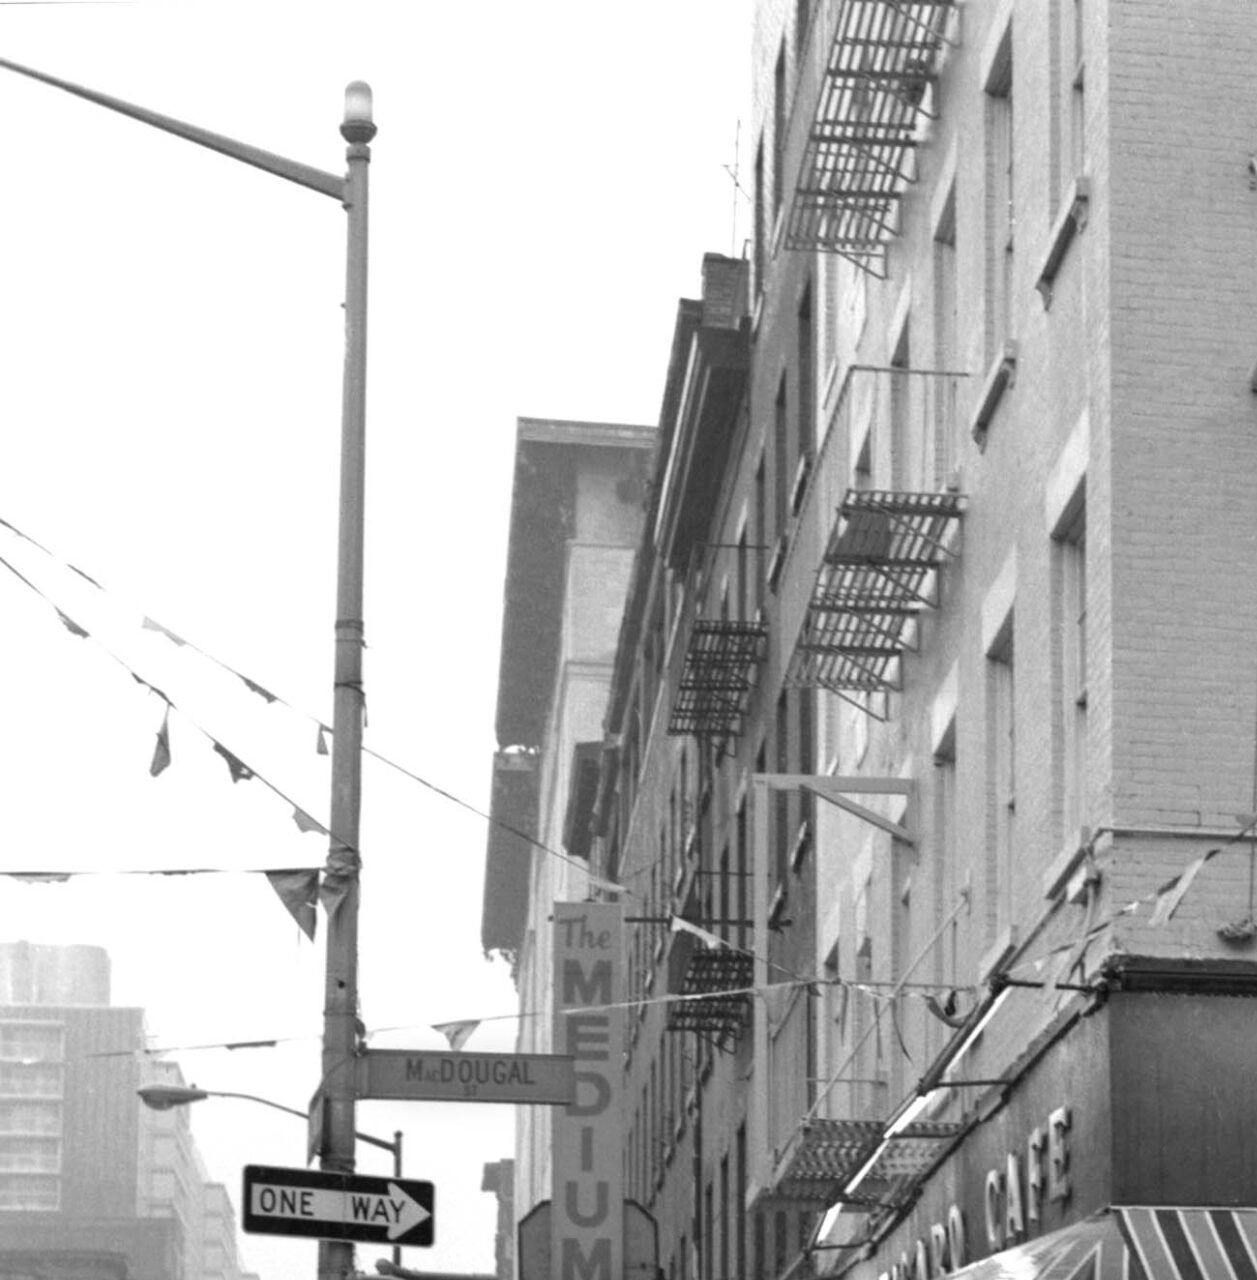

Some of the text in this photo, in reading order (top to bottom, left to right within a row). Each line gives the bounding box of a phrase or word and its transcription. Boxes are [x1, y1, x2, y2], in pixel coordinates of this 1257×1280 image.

[559, 914, 612, 949] The
[463, 1084, 478, 1097] ST
[985, 1107, 1071, 1251] CAFE
[259, 1187, 406, 1224] ONE WAY
